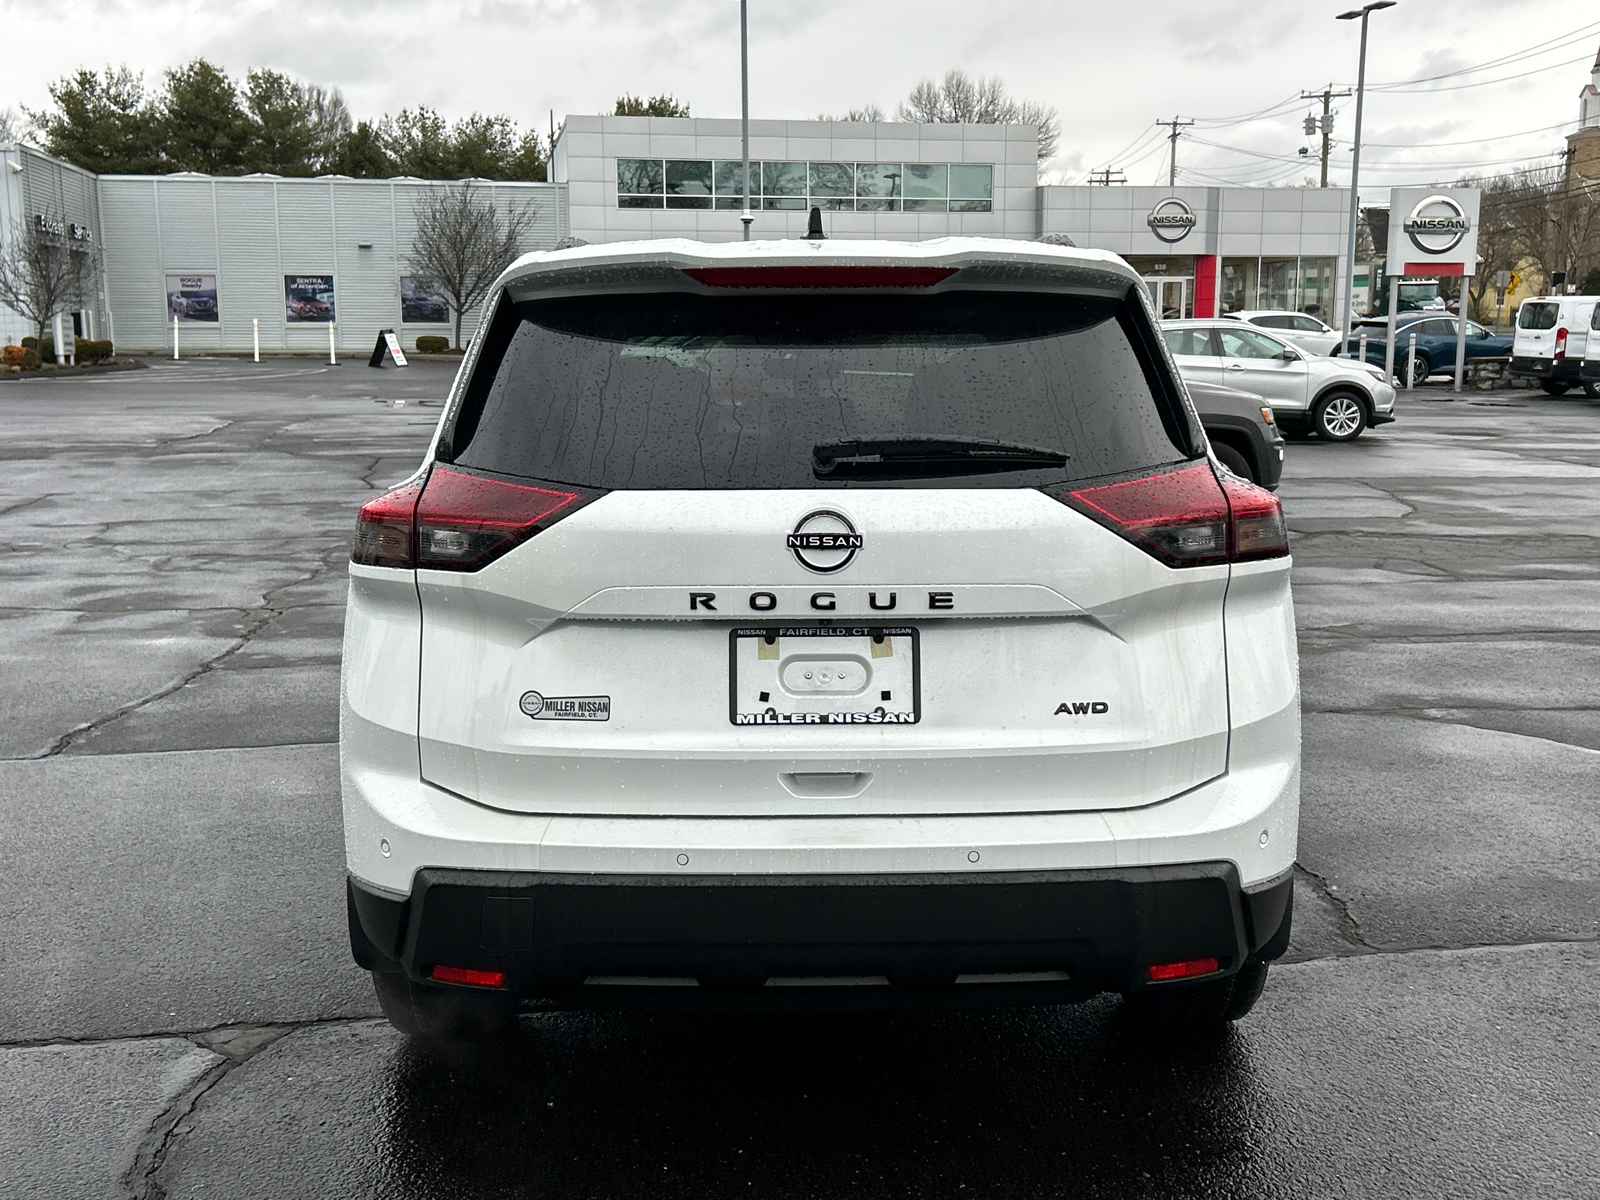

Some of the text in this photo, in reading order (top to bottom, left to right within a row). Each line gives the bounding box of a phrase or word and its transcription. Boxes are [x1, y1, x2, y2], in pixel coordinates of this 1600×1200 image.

[1152, 216, 1192, 224] NISSAN
[1411, 220, 1465, 229] NISSAN
[789, 536, 861, 547] NISSAN
[689, 592, 955, 611] ROGUE
[779, 628, 870, 636] FAIRFIELD, CT
[544, 700, 609, 713] MILLER NISSAN
[1053, 701, 1109, 716] AWD
[736, 712, 915, 724] MILLER NISSAN
